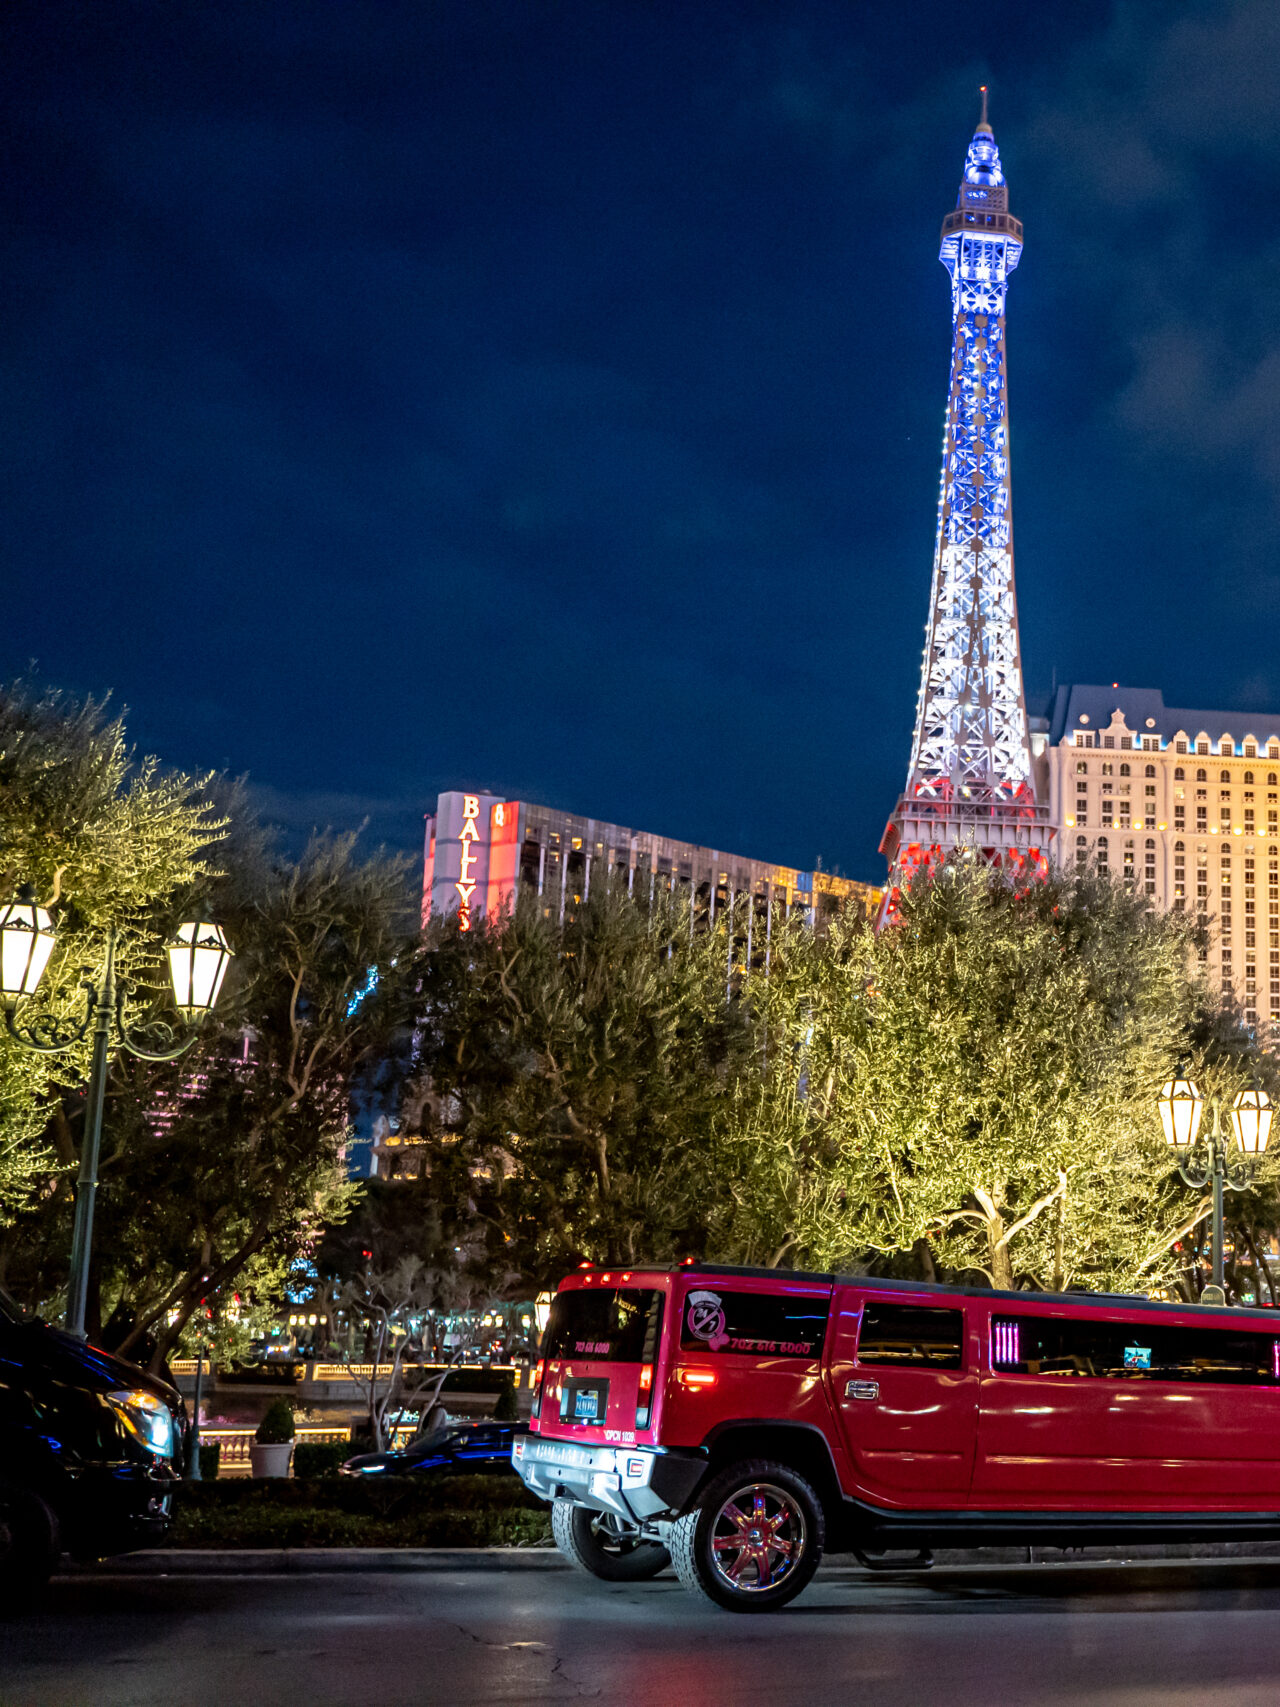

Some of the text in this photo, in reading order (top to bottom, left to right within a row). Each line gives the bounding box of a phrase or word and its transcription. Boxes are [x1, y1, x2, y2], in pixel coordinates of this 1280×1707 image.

[730, 1338, 810, 1354] 702 616 6000
